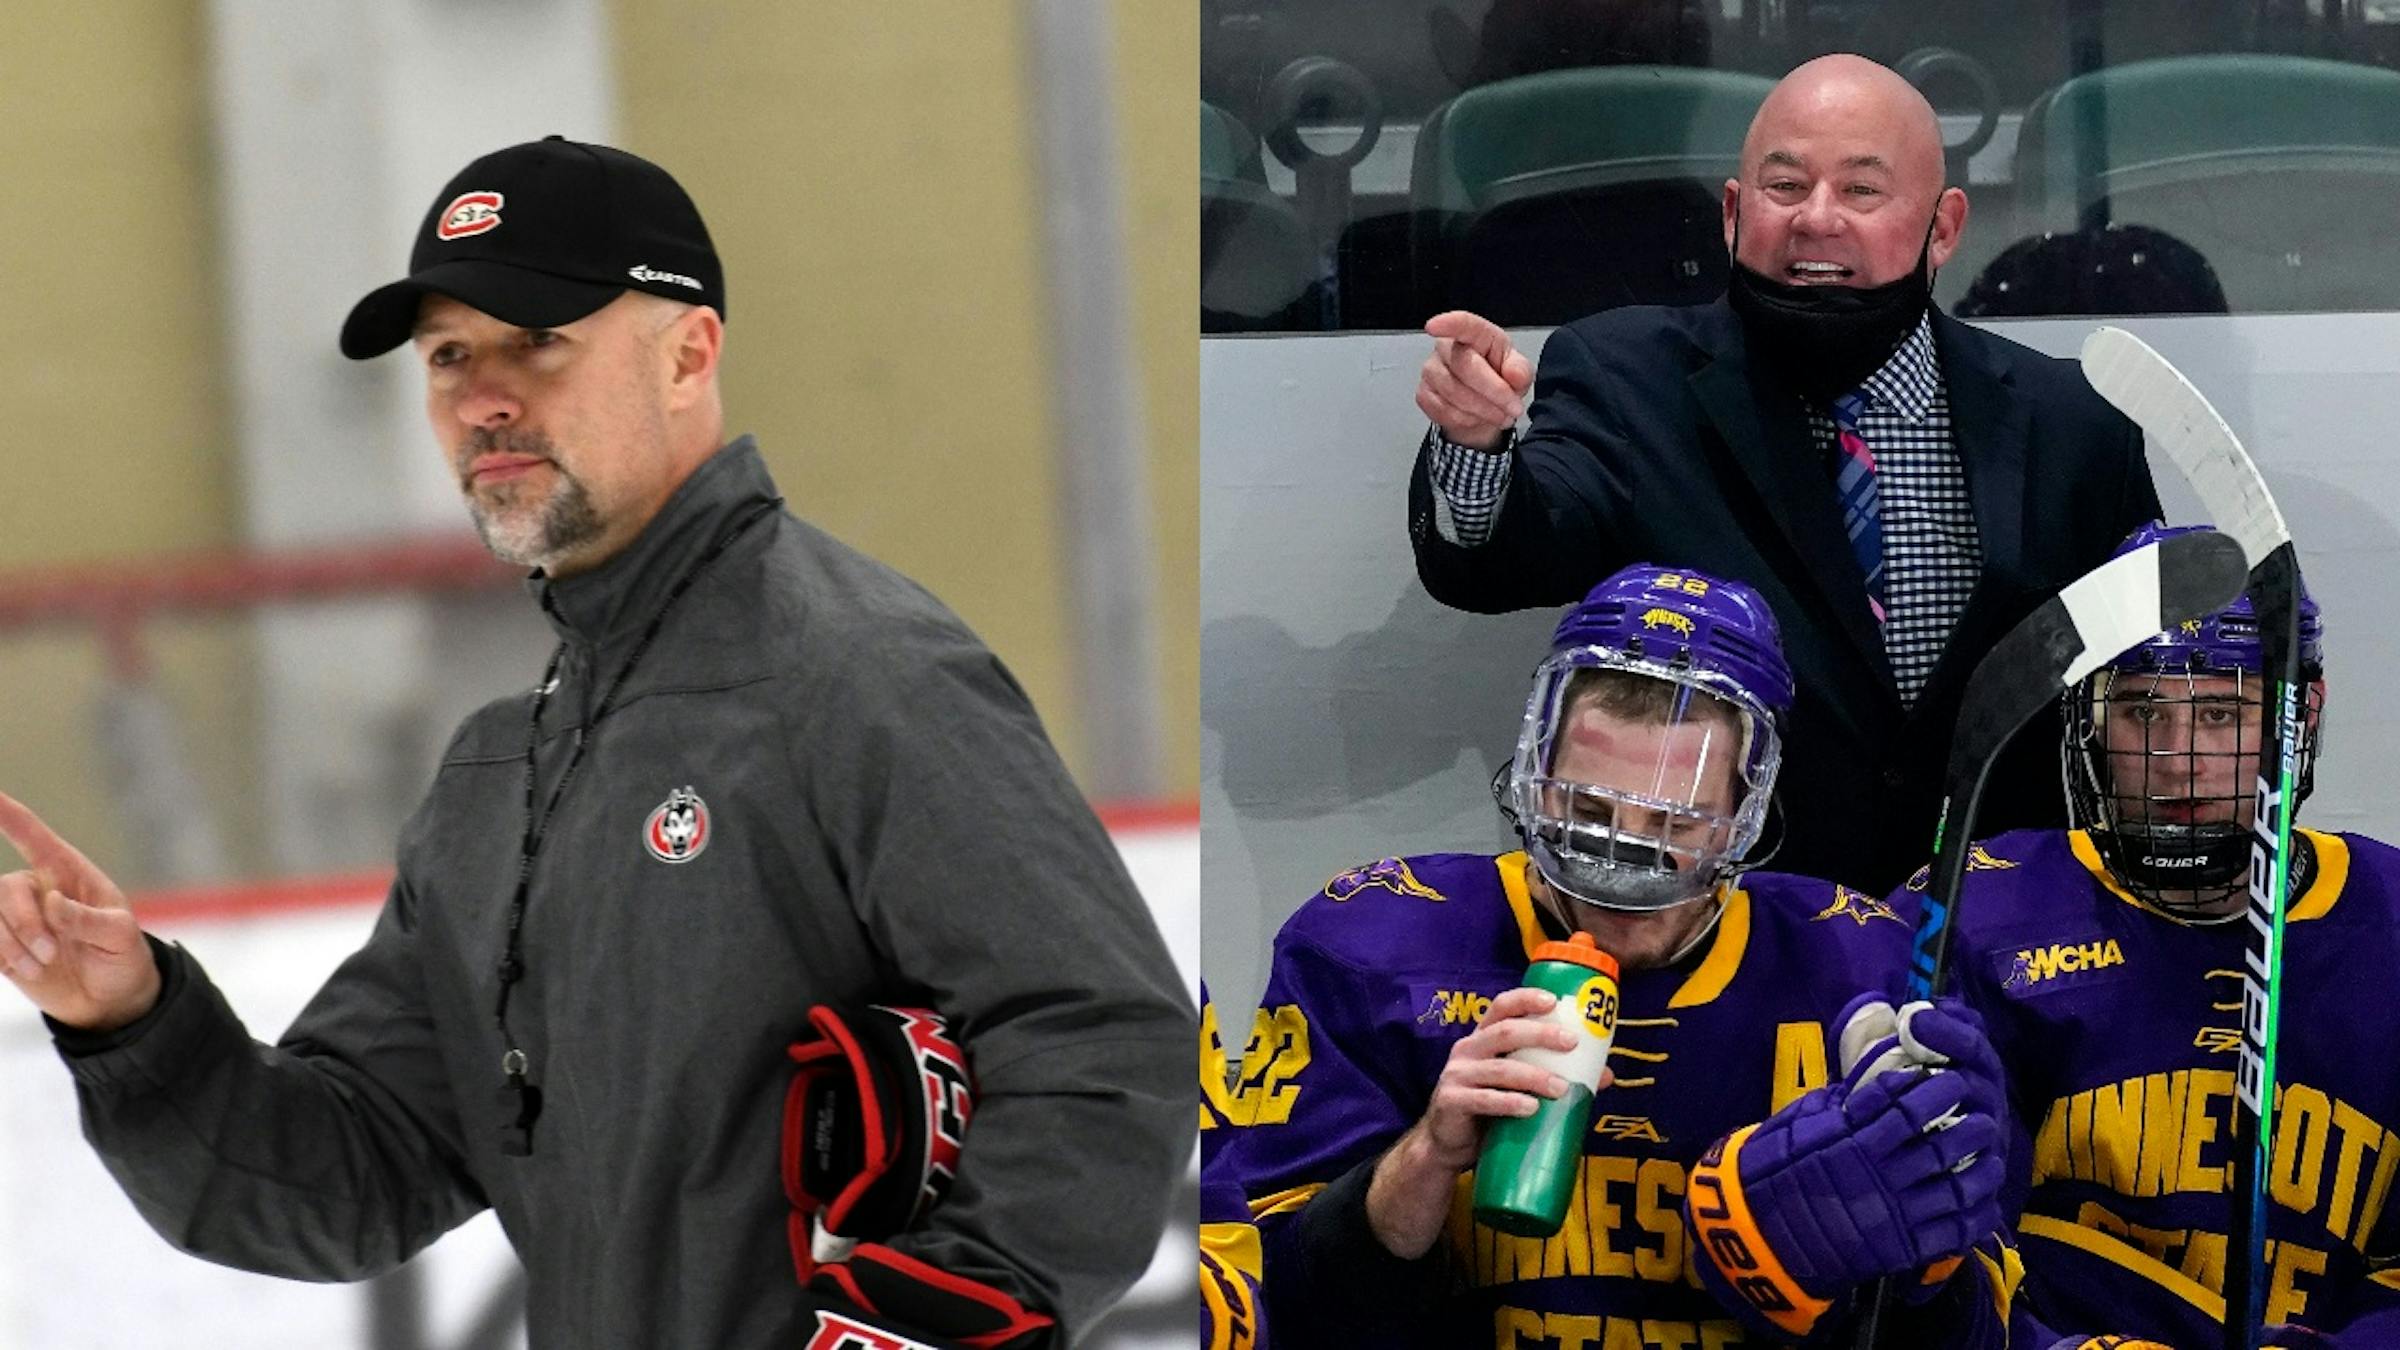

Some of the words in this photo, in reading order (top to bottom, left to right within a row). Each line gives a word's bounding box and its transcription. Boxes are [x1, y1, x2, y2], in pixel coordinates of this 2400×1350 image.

[1682, 260, 1700, 277] 13
[1654, 573, 1710, 597] 22
[2017, 938, 2127, 983] WCHA
[1586, 987, 1616, 1030] 28
[1771, 1020, 1829, 1117] A
